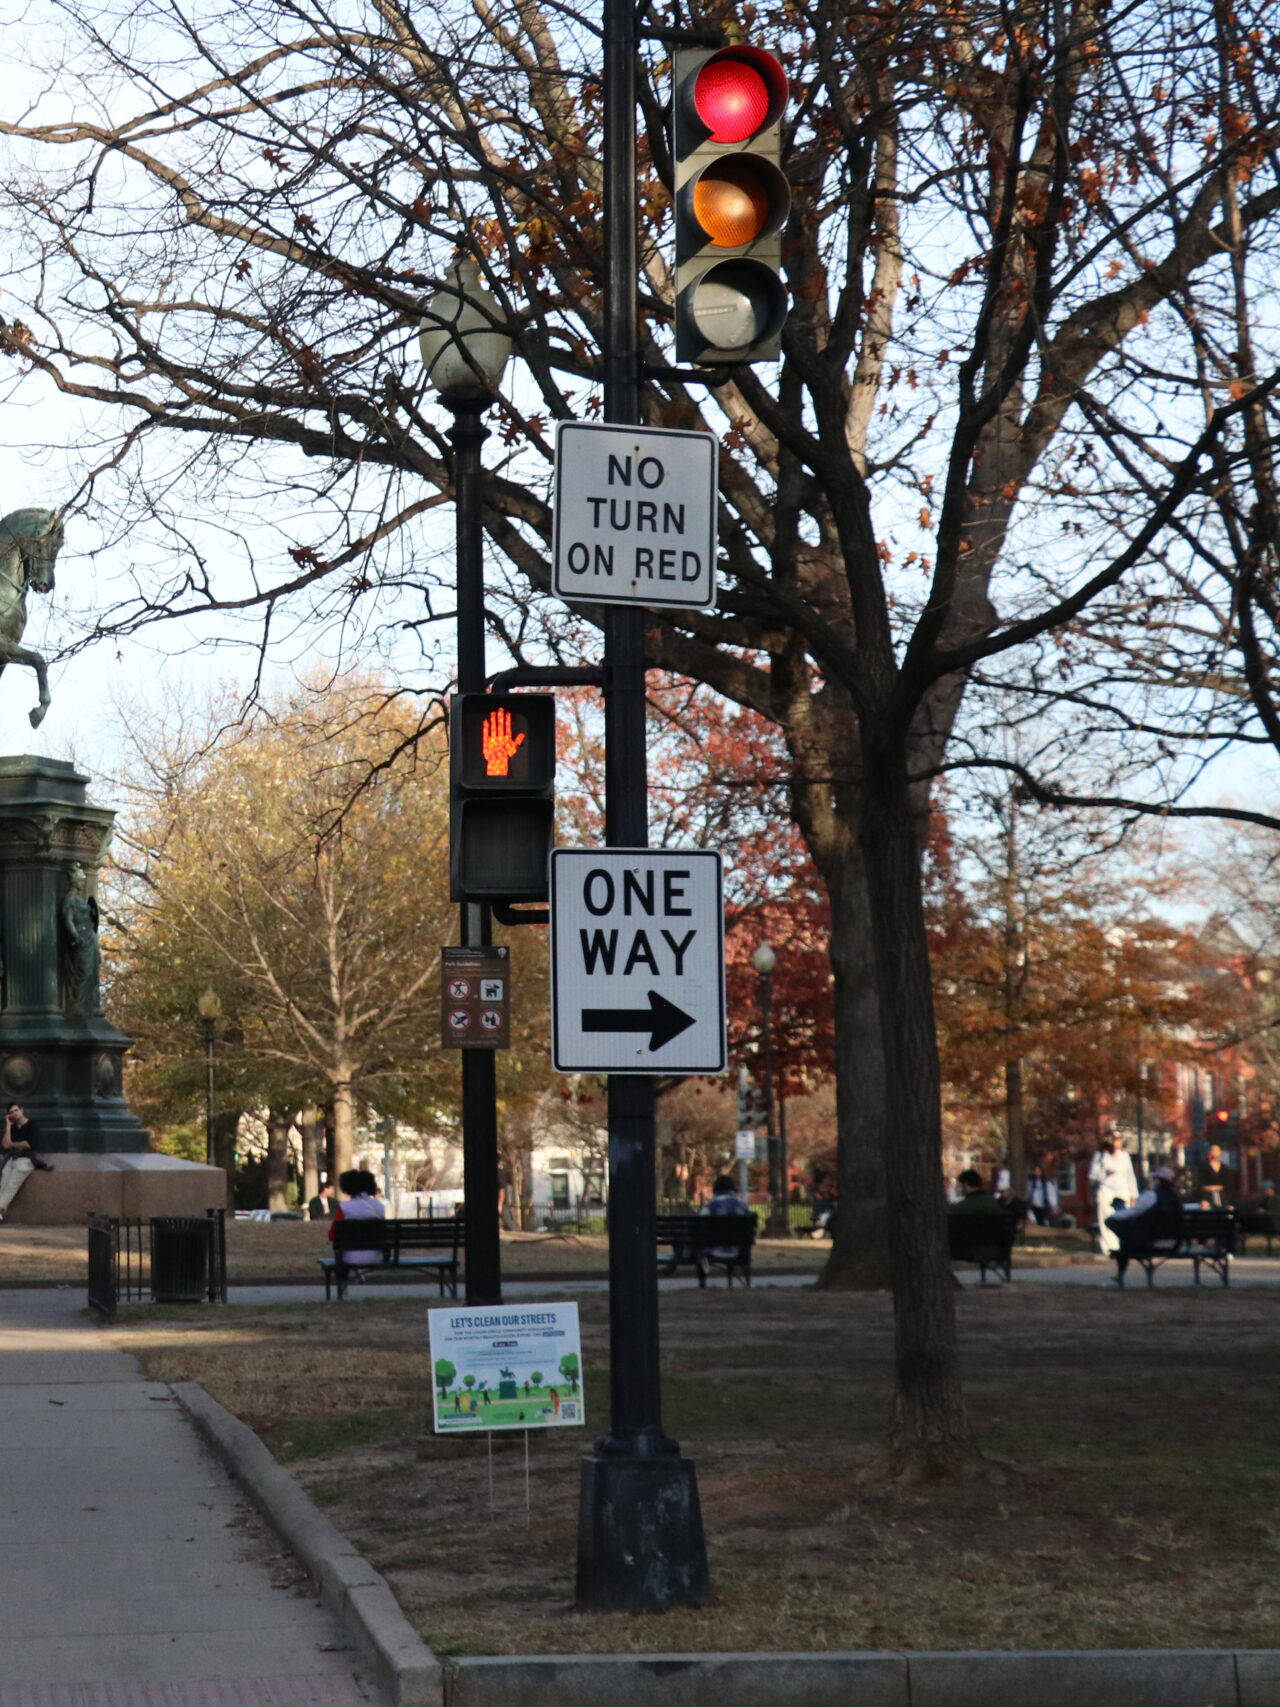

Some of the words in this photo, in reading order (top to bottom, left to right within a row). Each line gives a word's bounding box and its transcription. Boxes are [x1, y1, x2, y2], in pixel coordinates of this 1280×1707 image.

[608, 454, 665, 489] NO
[587, 497, 685, 535] TURN
[567, 542, 614, 576] ON
[635, 547, 702, 582] RED
[583, 868, 692, 916] ONE
[579, 928, 697, 976] WAY
[451, 1317, 473, 1328] LET'S
[474, 1315, 501, 1327] CLEAN
[502, 1315, 520, 1326] OUR
[521, 1313, 557, 1325] STREETS
